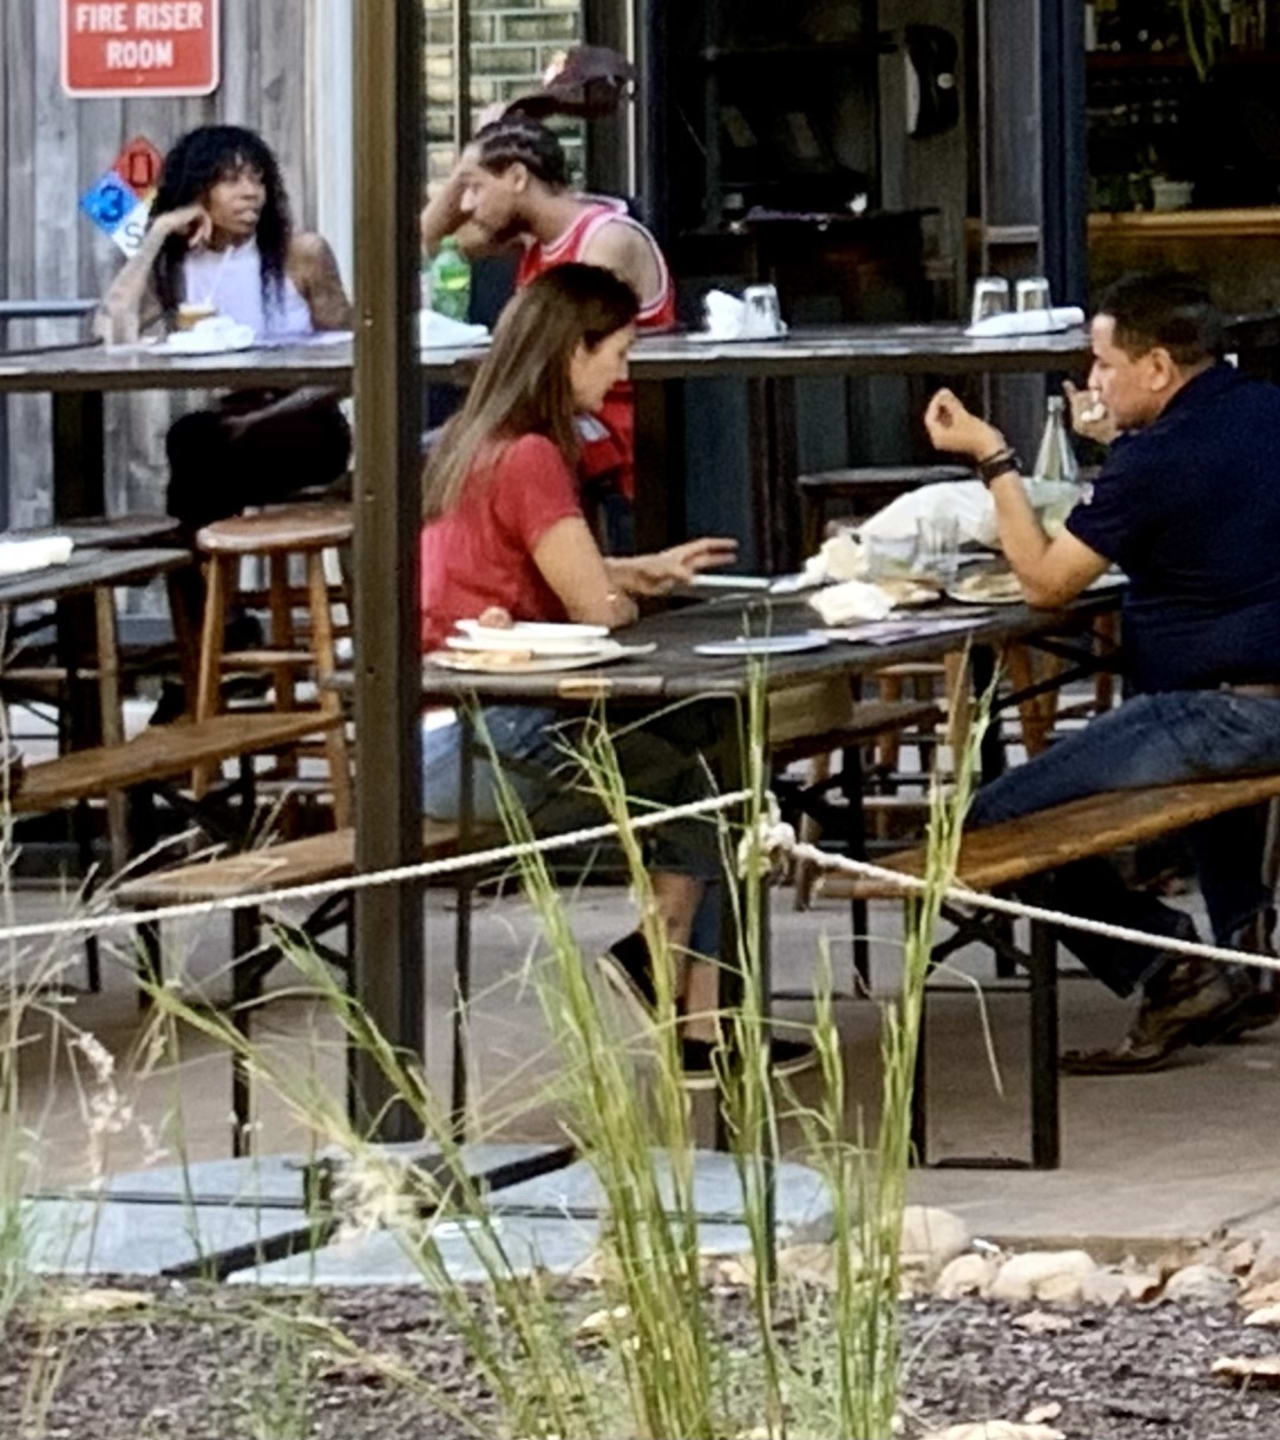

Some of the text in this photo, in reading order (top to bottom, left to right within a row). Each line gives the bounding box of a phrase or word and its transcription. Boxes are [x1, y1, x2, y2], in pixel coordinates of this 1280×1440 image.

[76, 0, 204, 32] FIRE RISER
[106, 39, 174, 69] ROOM
[128, 150, 153, 189] 0
[100, 184, 124, 223] 3
